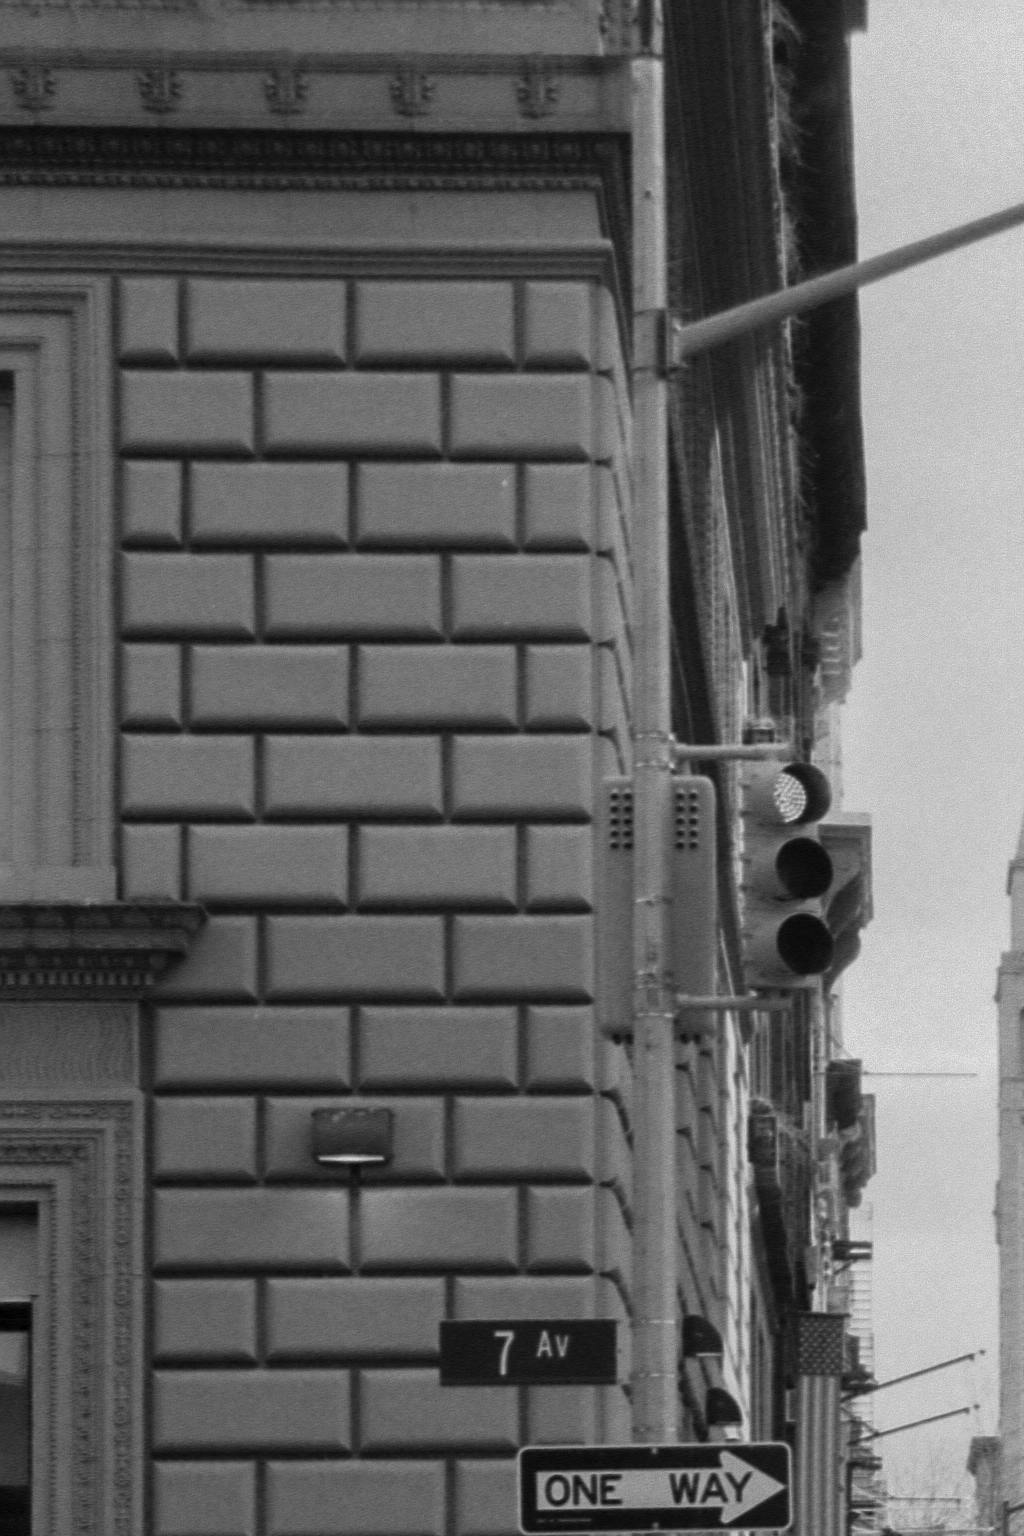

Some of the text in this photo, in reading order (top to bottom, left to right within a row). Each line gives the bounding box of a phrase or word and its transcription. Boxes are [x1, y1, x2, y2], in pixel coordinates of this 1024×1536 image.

[494, 1330, 515, 1376] 7
[544, 1470, 753, 1507] ONE WAY
